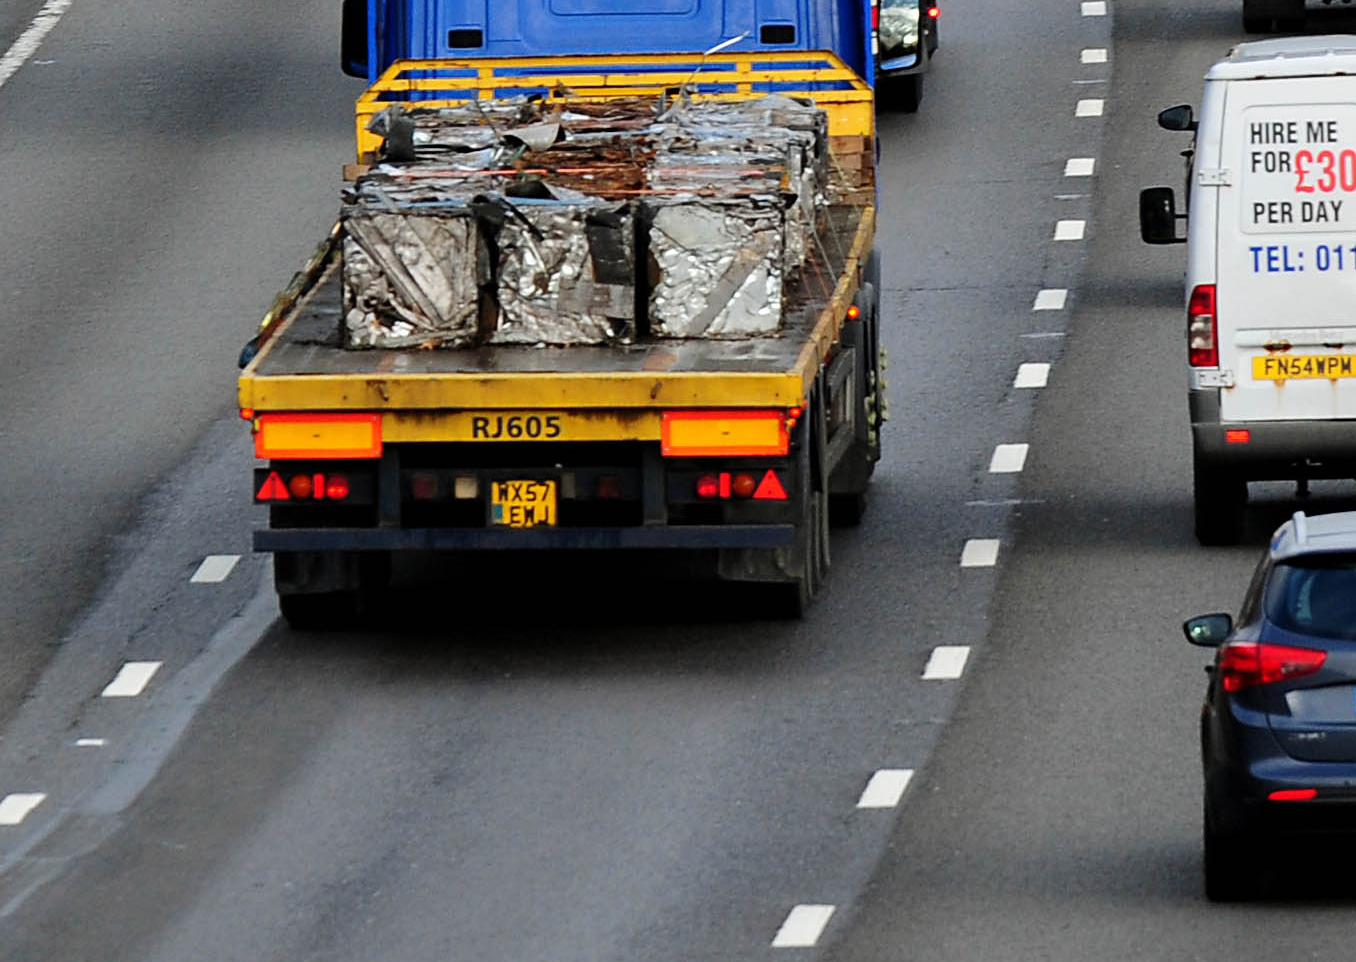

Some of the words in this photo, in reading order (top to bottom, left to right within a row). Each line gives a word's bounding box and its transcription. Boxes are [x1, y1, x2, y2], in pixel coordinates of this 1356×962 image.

[1251, 121, 1298, 145] HIRE
[1307, 120, 1337, 143] ME
[1251, 150, 1291, 173] FOR
[1253, 201, 1293, 224] PER
[1301, 200, 1343, 223] DAY
[1249, 245, 1304, 273] TEL:
[1264, 356, 1352, 376] FN54WPM
[472, 415, 561, 438] RJ605
[498, 482, 551, 502] WX57
